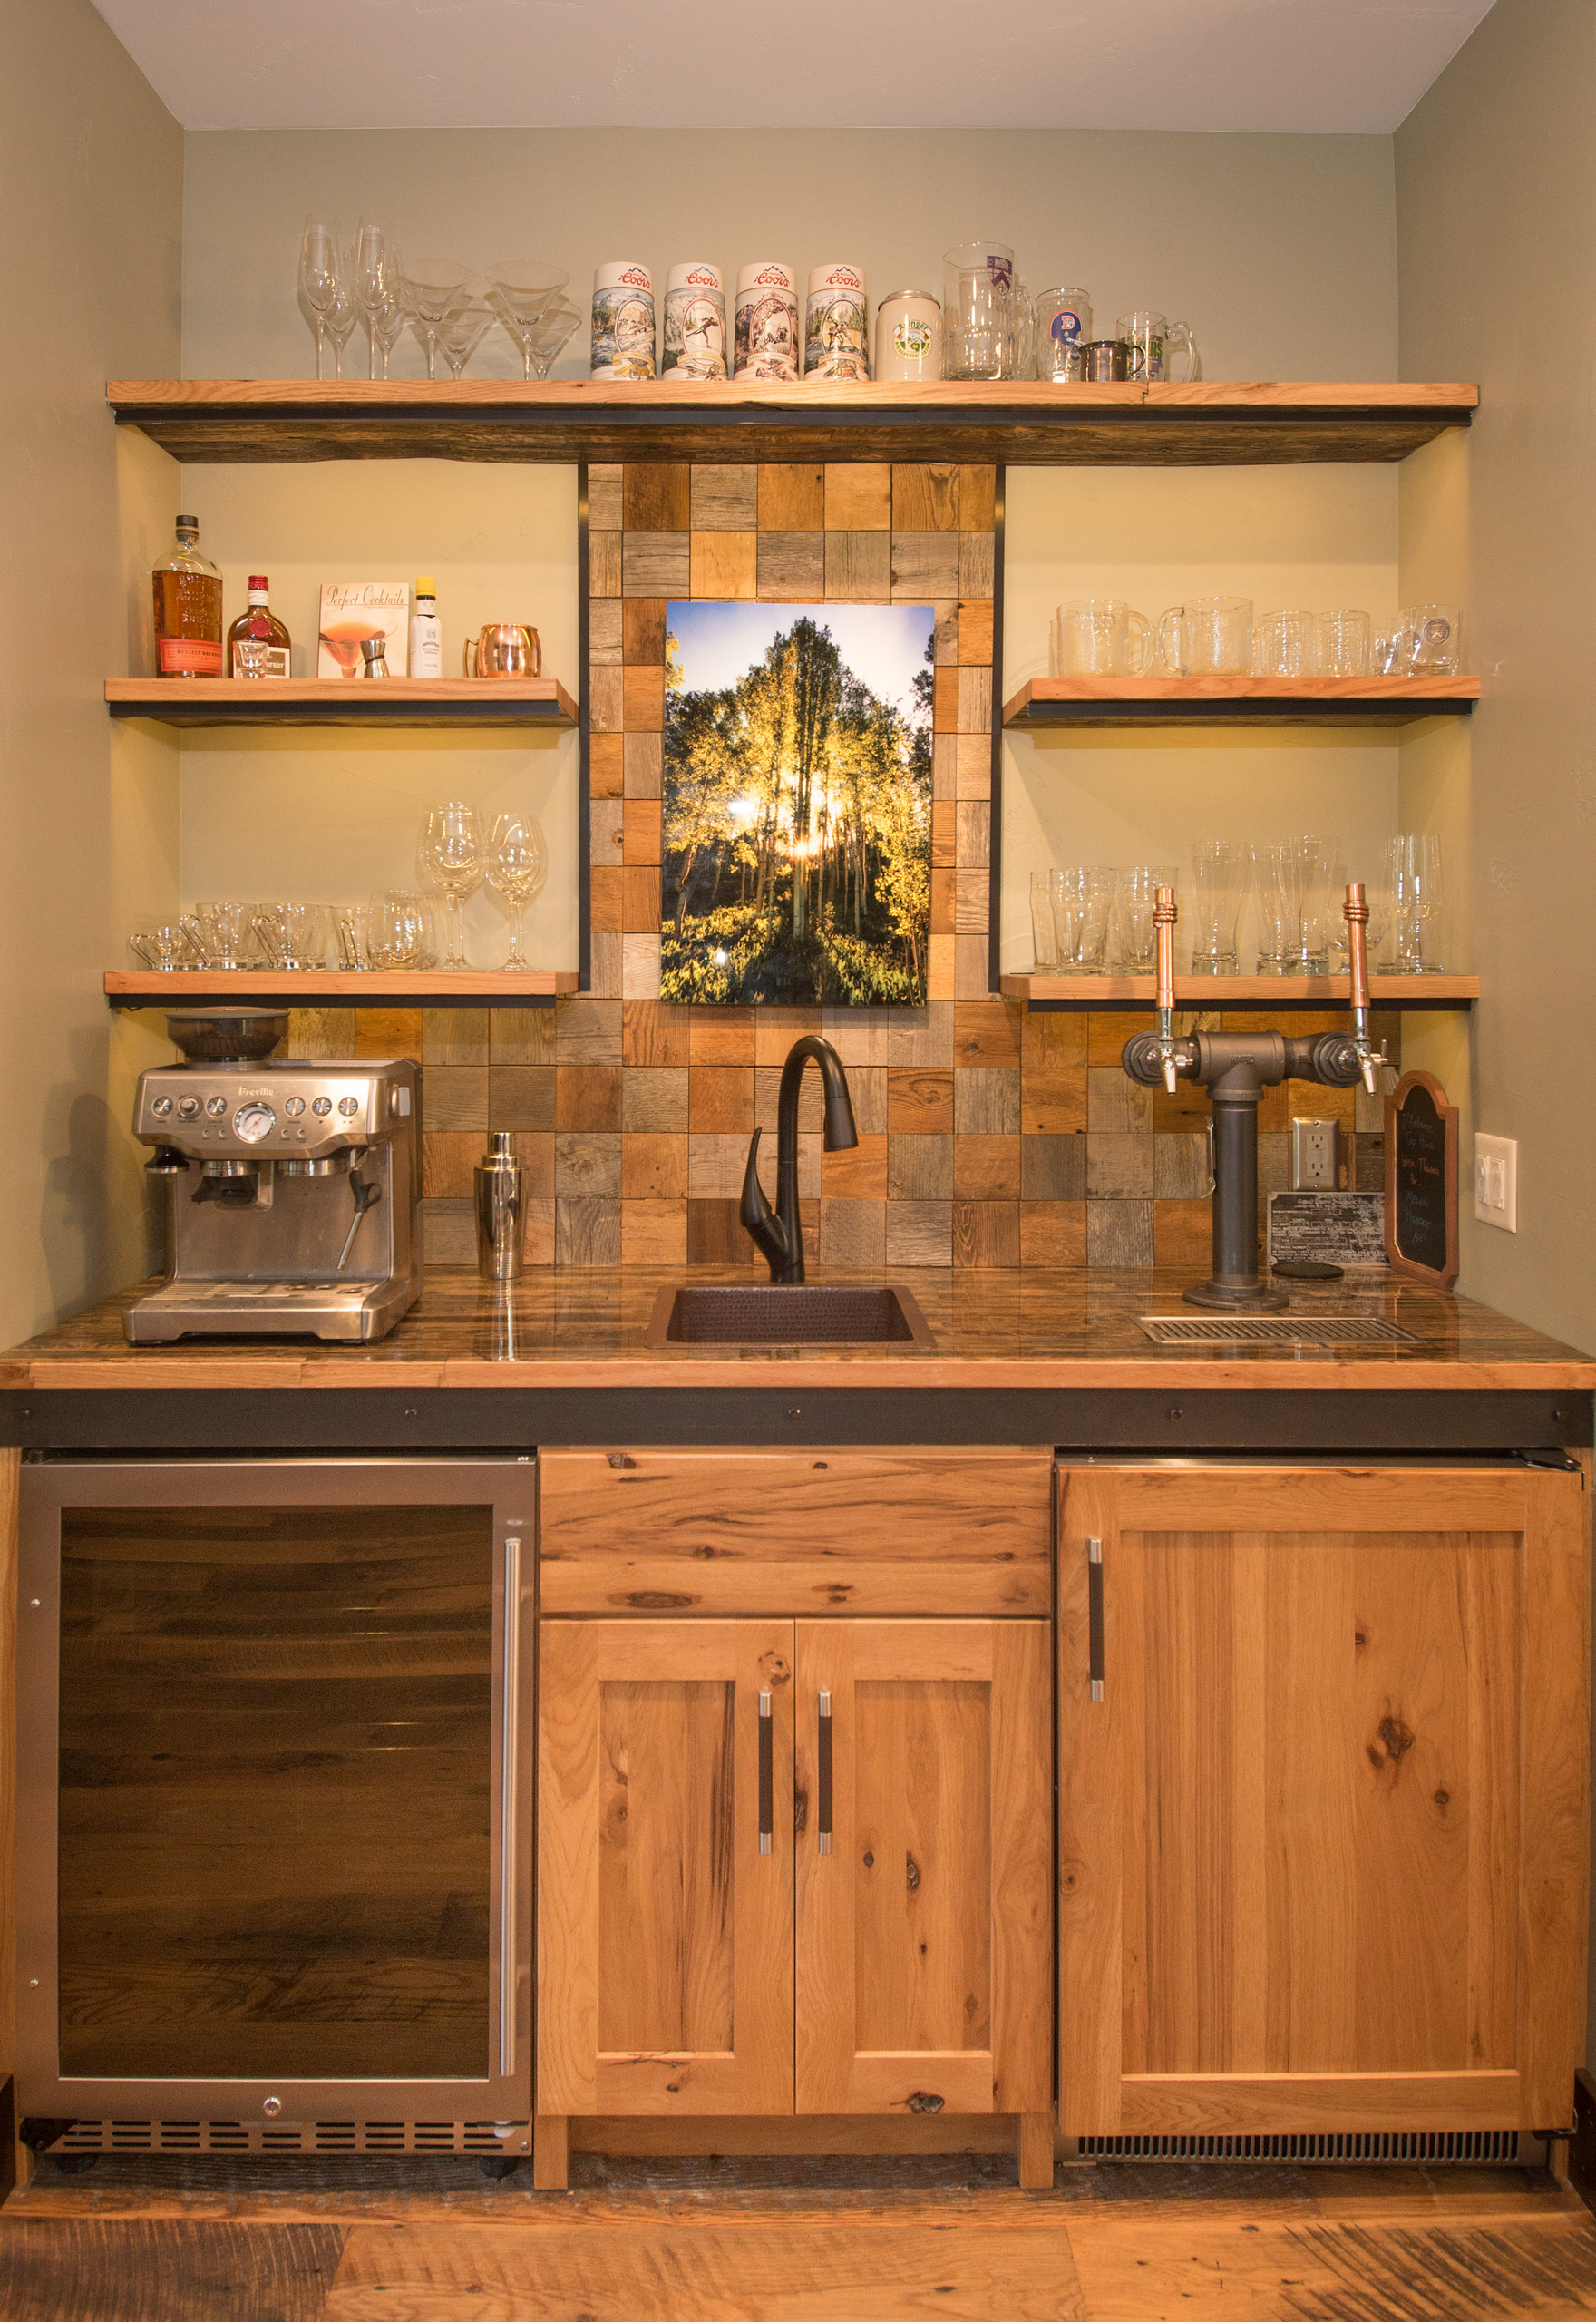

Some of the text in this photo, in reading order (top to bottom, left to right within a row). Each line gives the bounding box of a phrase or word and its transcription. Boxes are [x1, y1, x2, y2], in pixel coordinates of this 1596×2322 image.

[621, 272, 650, 288] Coors
[686, 272, 719, 288] Coors
[756, 272, 789, 288] Coors
[828, 272, 861, 288] Coors
[899, 320, 928, 331] Ainger
[326, 585, 404, 610] Perfect Cocktails
[238, 1086, 274, 1097] Breville
